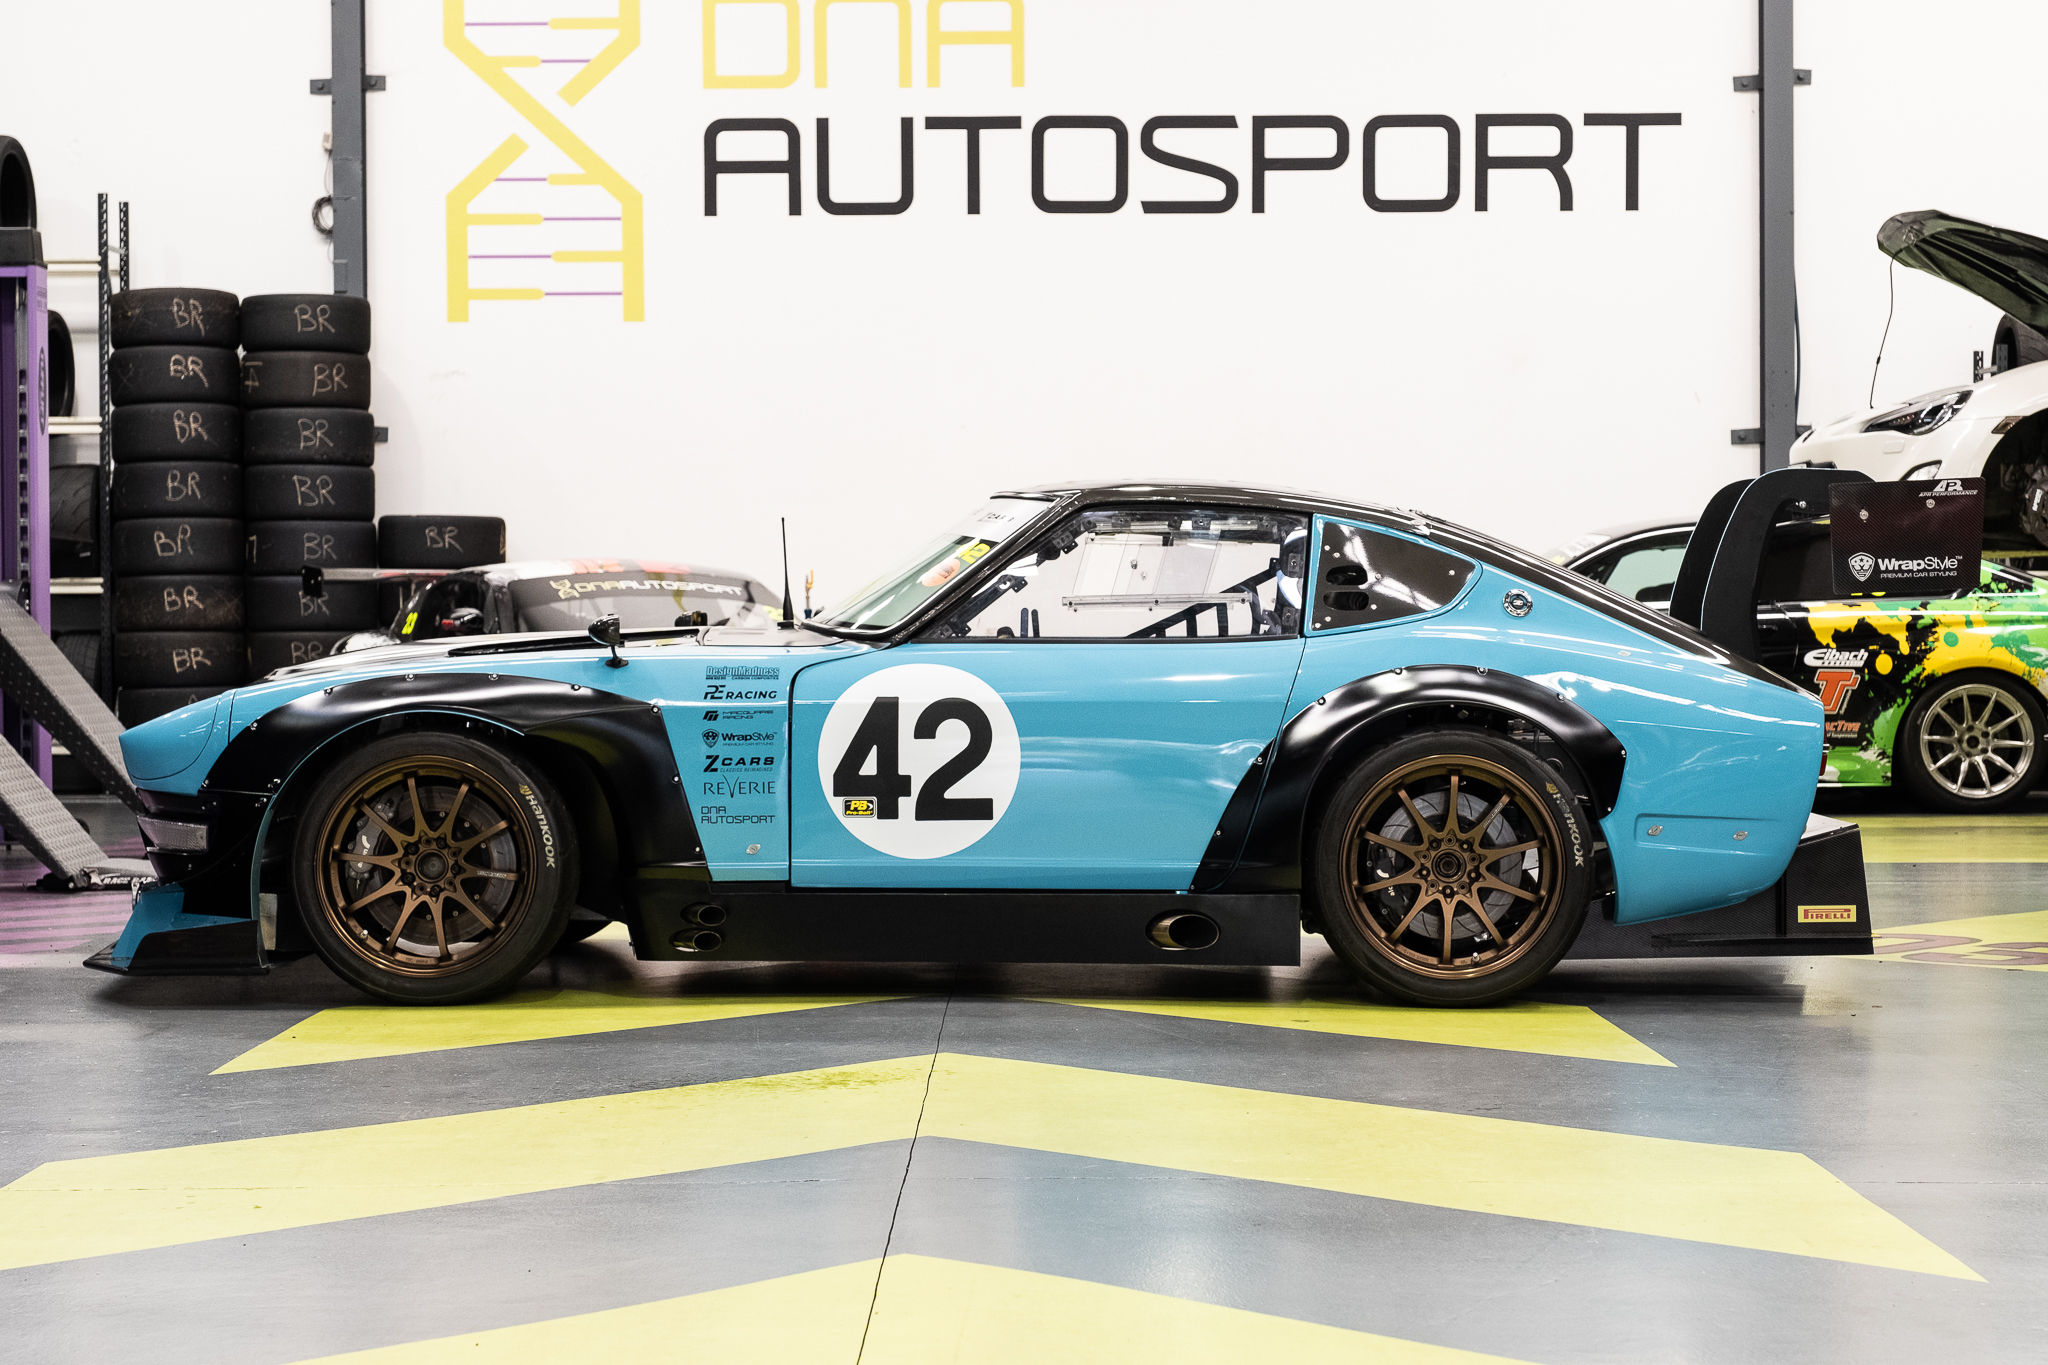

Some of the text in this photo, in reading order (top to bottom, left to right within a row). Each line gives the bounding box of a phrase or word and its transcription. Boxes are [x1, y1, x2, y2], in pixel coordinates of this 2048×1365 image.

[702, 0, 1026, 89] DNA
[704, 113, 1682, 216] AUTOSPORT
[172, 298, 205, 337] BR
[294, 304, 335, 333] BR
[170, 354, 209, 388] BR
[312, 363, 348, 397] BR
[173, 409, 208, 443] BR
[298, 418, 334, 450] BR
[166, 470, 201, 501] BR
[292, 475, 336, 506] BR
[154, 524, 194, 556] BR
[303, 533, 337, 560] BR
[425, 526, 464, 553] BR
[164, 585, 204, 612] BR
[173, 647, 211, 674] BR
[1803, 648, 1869, 667] Eibach
[726, 690, 777, 699] RACING
[722, 757, 774, 766] CARS
[833, 696, 994, 821] 42
[701, 806, 726, 814] DNA
[701, 815, 775, 824] AUTOSPORT
[850, 801, 868, 810] PB
[1803, 909, 1851, 919] PIRELLI
